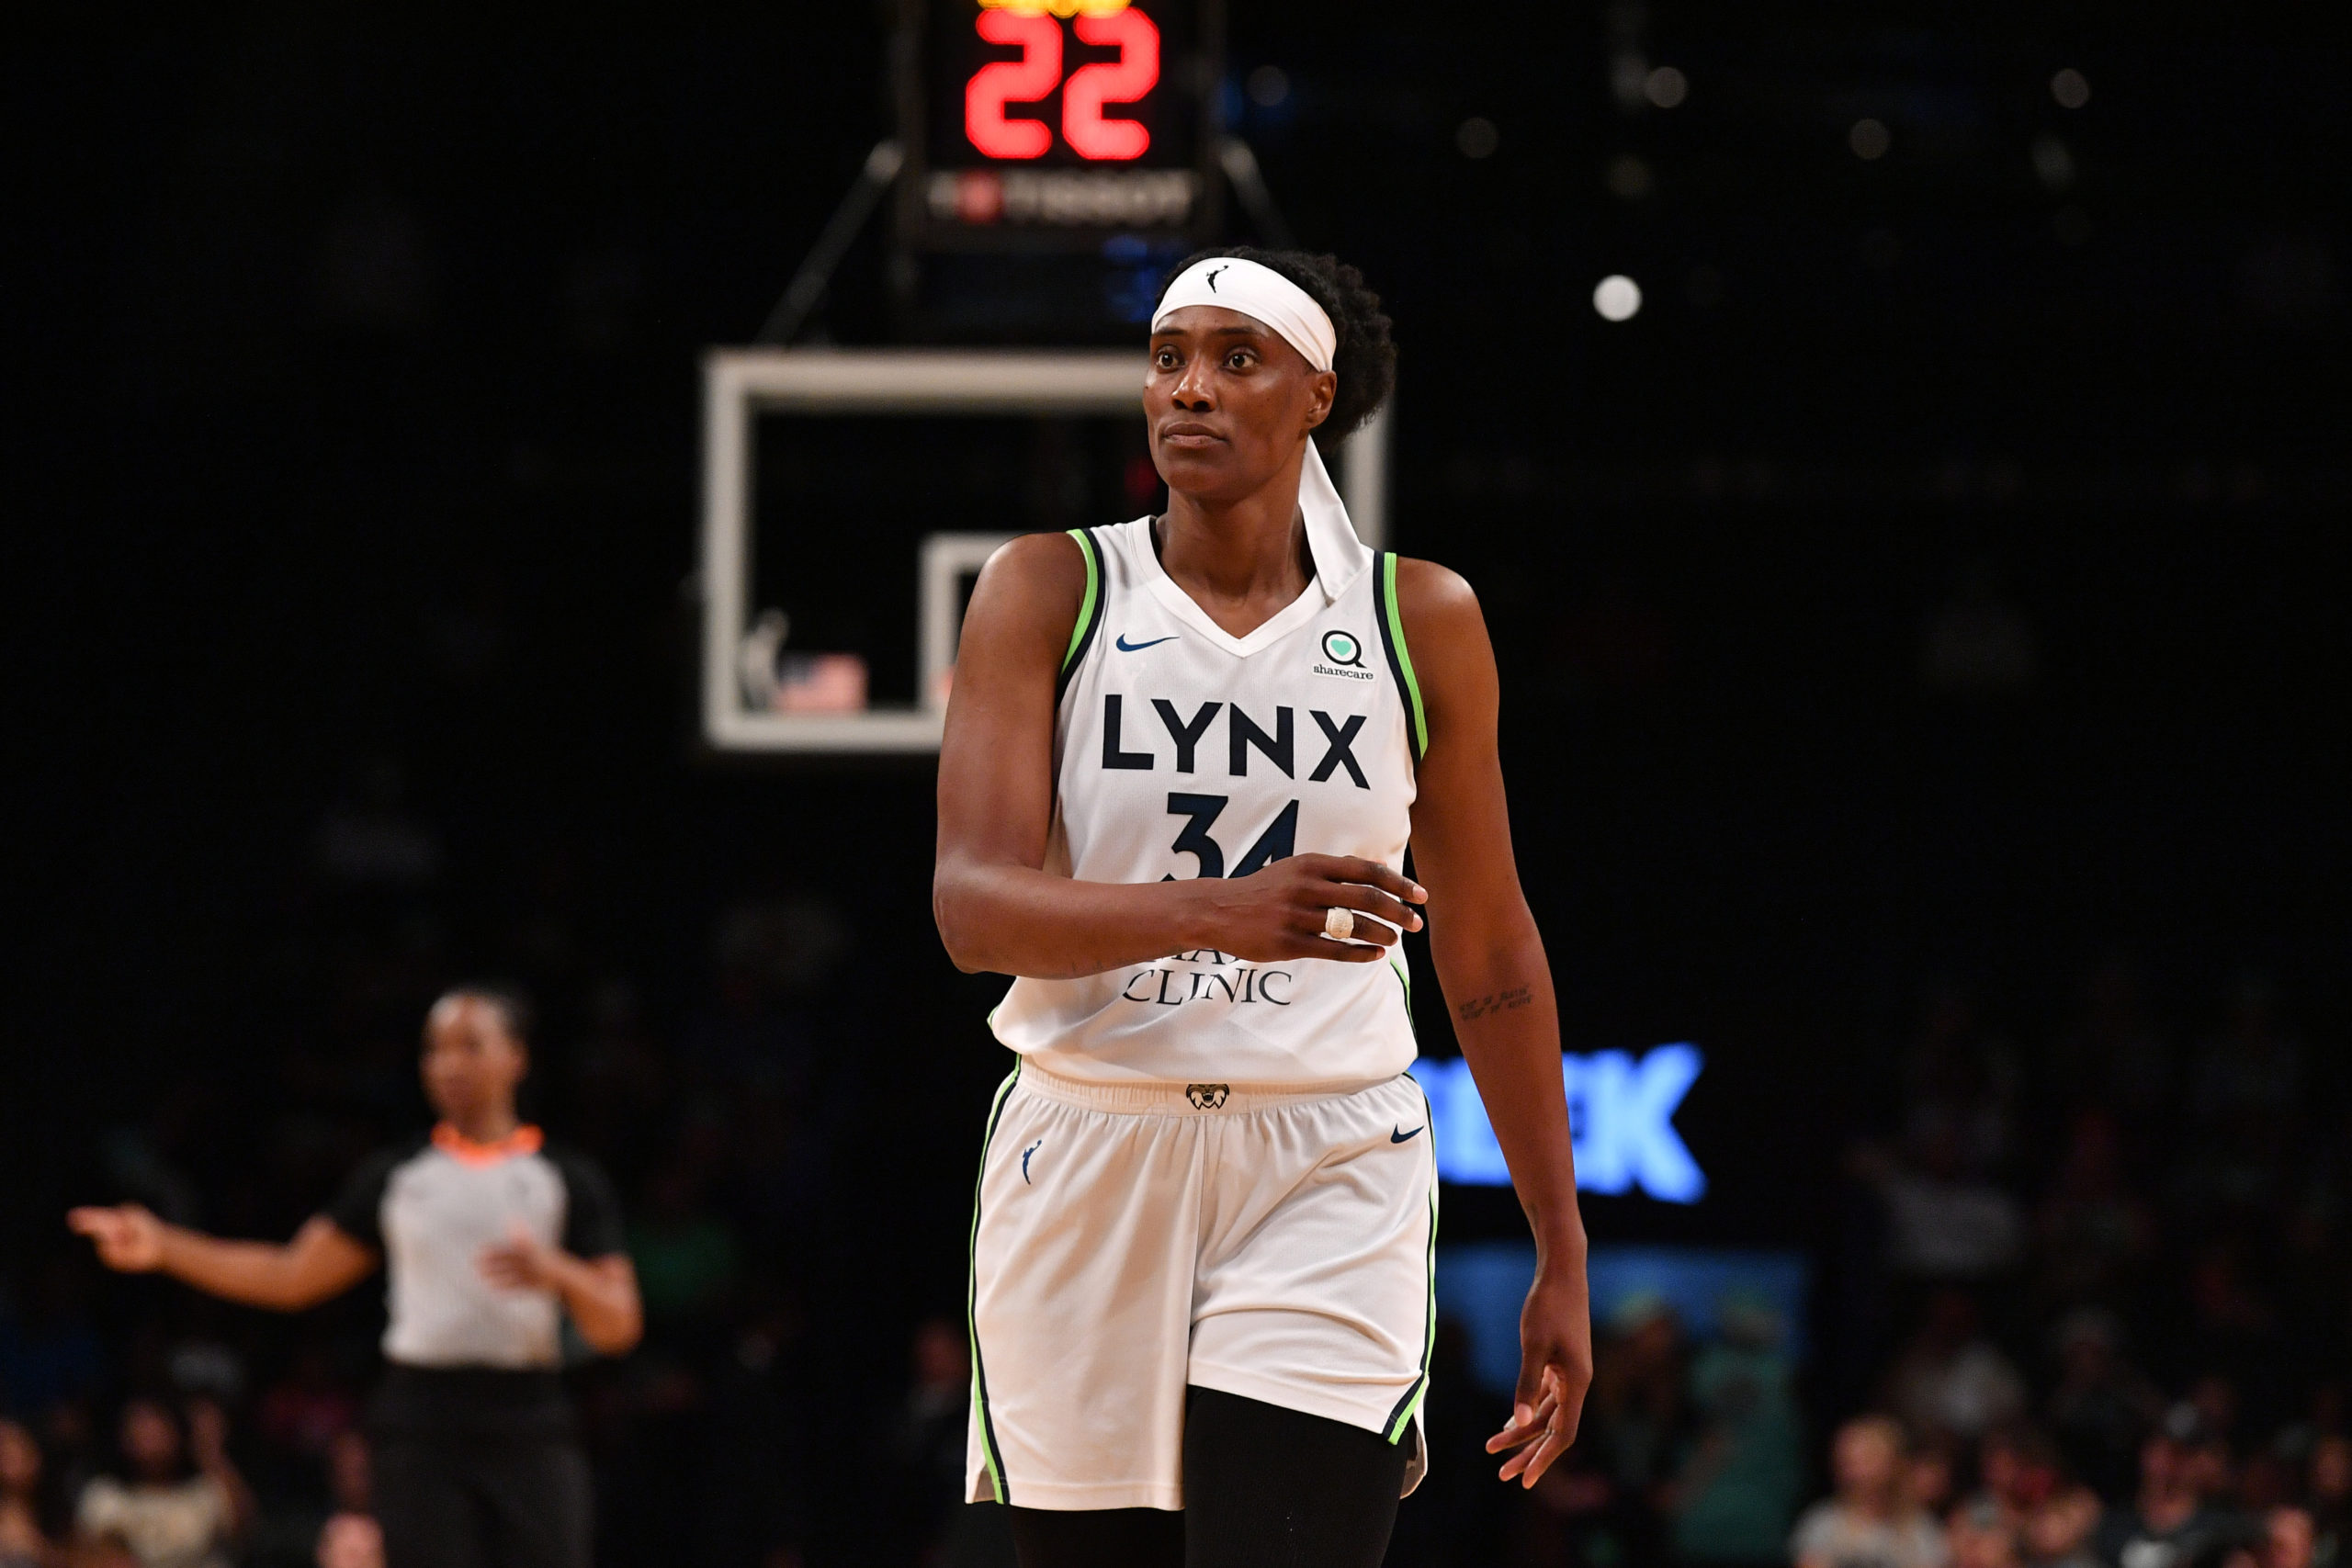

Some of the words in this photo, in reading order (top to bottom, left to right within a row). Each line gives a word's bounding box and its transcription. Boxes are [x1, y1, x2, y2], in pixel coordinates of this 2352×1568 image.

[966, 6, 1160, 160] 22
[1313, 663, 1374, 680] sharecare
[1102, 694, 1371, 790] LYNX
[1161, 792, 1299, 881] 34
[1123, 967, 1292, 1006] CLINIC
